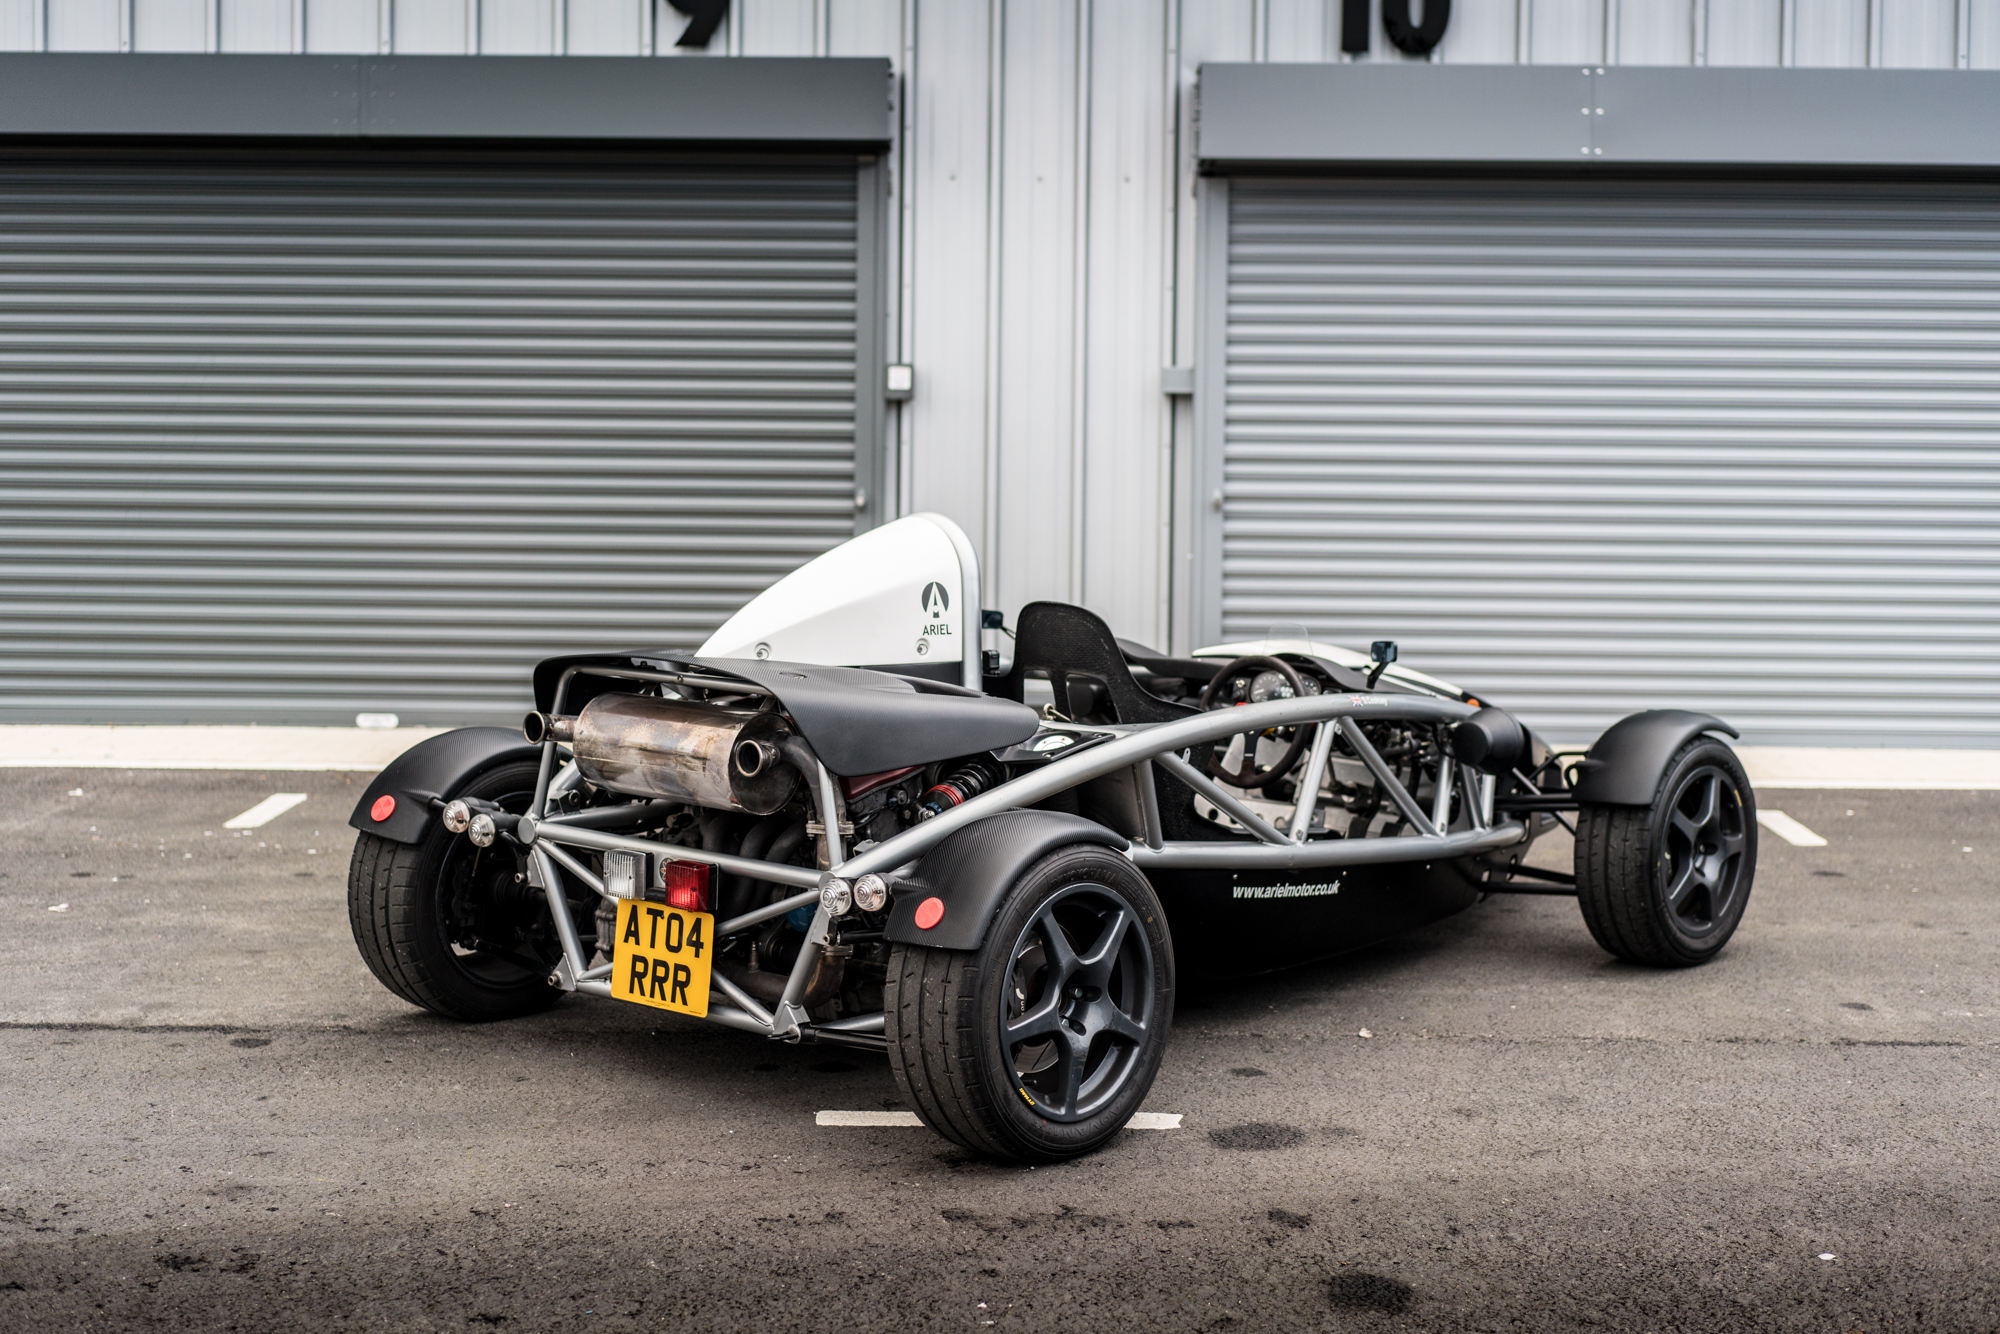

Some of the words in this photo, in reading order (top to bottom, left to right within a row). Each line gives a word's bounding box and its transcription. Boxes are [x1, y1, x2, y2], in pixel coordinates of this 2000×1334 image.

[922, 624, 952, 636] ARIEL
[1233, 880, 1340, 899] www.arielmotor.co.uk
[623, 904, 704, 959] AT04
[629, 954, 691, 1007] RRR
